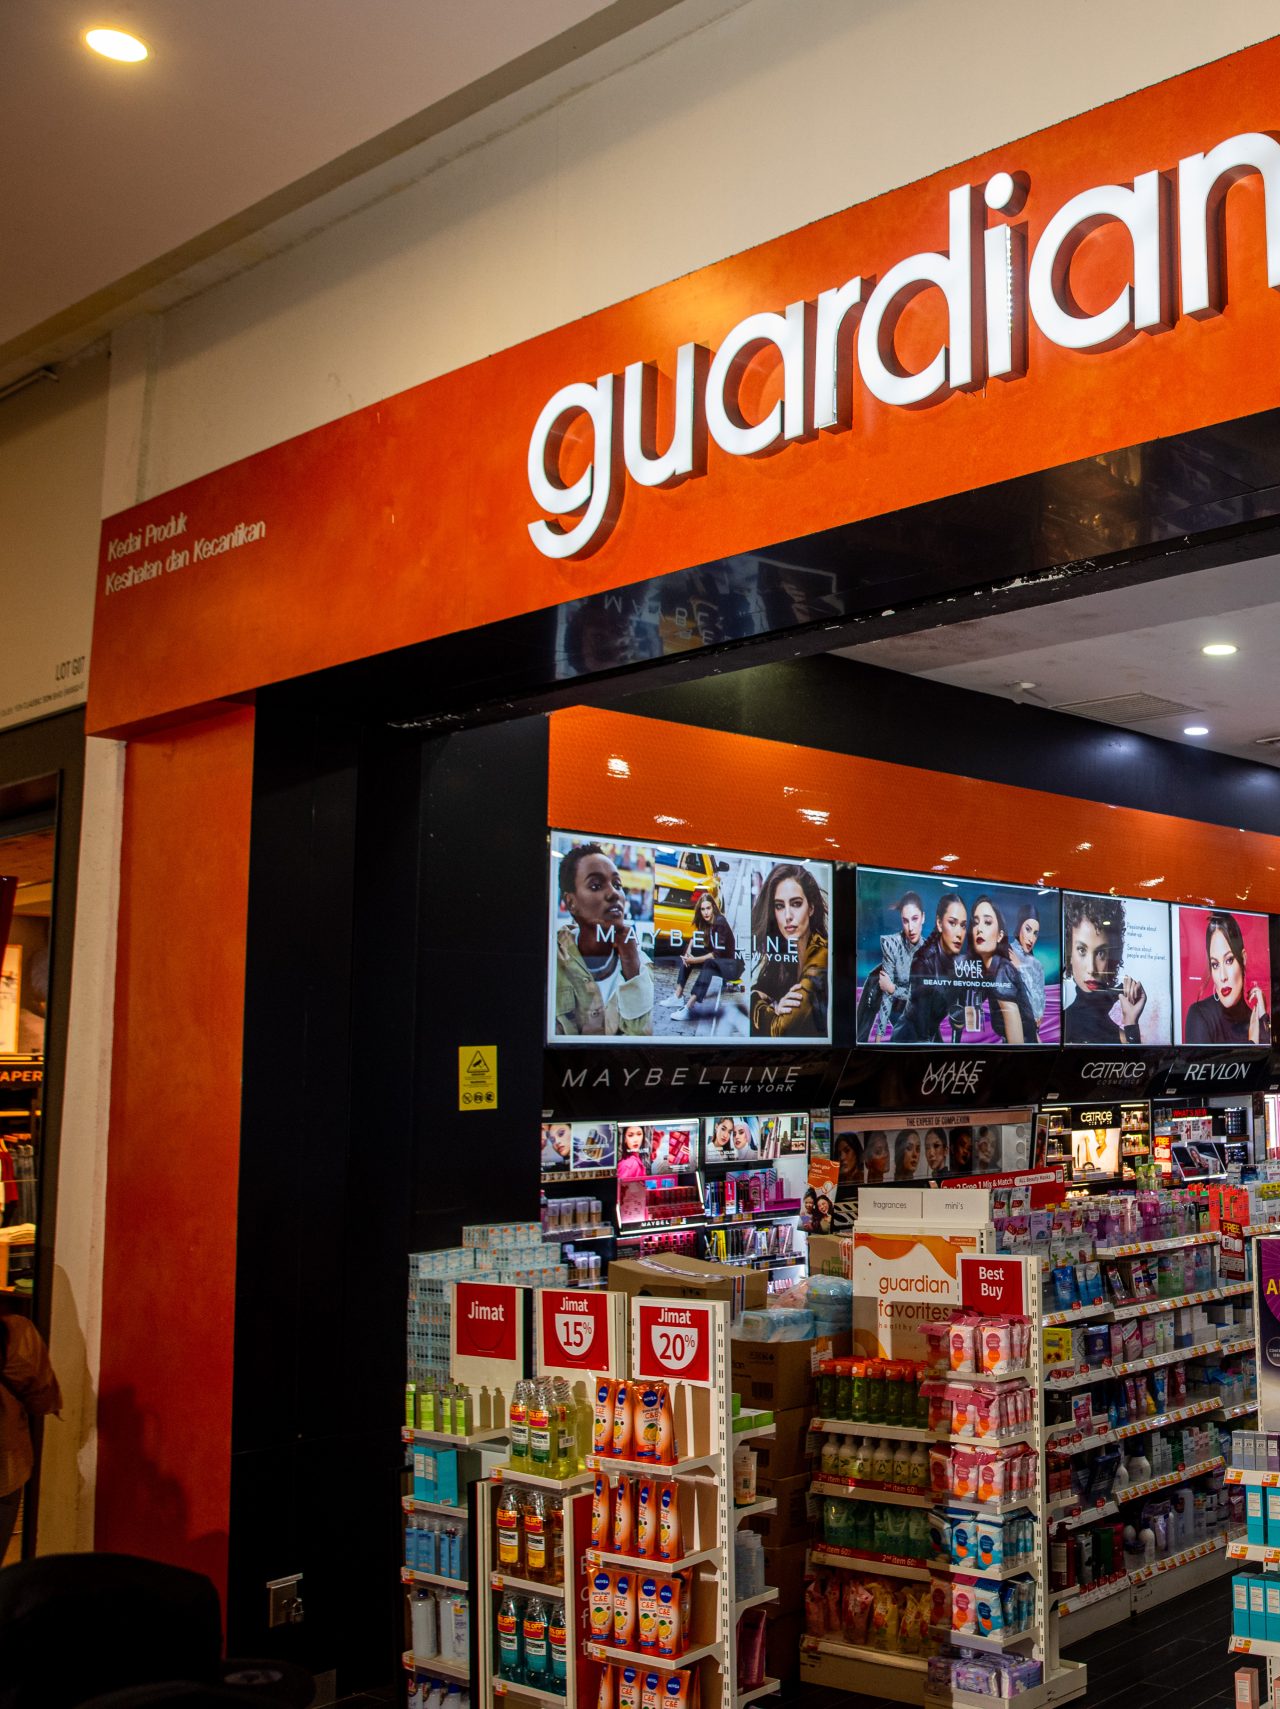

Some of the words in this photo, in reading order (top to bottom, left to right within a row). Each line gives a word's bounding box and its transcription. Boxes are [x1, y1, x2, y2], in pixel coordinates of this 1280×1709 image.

[108, 529, 142, 562] Kedai
[145, 512, 188, 547] Produk
[105, 560, 163, 596] Kesihatan
[165, 549, 190, 573] dan
[193, 520, 266, 563] Kecantikan
[595, 923, 801, 955] MAYBELLINE
[734, 951, 764, 962] NEW
[764, 952, 799, 964] YORK
[923, 978, 952, 986] BEAUTY
[953, 979, 981, 987] BEYOND
[561, 1066, 803, 1088] MAYBELLINE
[1183, 1062, 1251, 1082] REVLON
[718, 1085, 751, 1094] NEW
[756, 1083, 795, 1093] YORK
[906, 1117, 916, 1127] THE
[916, 1116, 934, 1127] EXPERT
[934, 1116, 941, 1126] OF
[941, 1115, 970, 1126] COMPLEXION
[997, 1178, 1014, 1187] Match
[872, 1200, 907, 1210] fragrances
[944, 1201, 964, 1211] mini's
[1222, 1221, 1241, 1235] FREE
[978, 1266, 1005, 1281] Best
[878, 1274, 950, 1295] guardian
[980, 1283, 1003, 1301] Buy
[467, 1300, 505, 1322] Jimat
[559, 1296, 589, 1313] Jimat
[878, 1299, 950, 1322] favorites
[657, 1307, 692, 1325] Jimat
[562, 1320, 593, 1348] 15%
[658, 1332, 696, 1361] 20%
[828, 1474, 841, 1484] item
[893, 1484, 906, 1494] item
[893, 1555, 906, 1565] item
